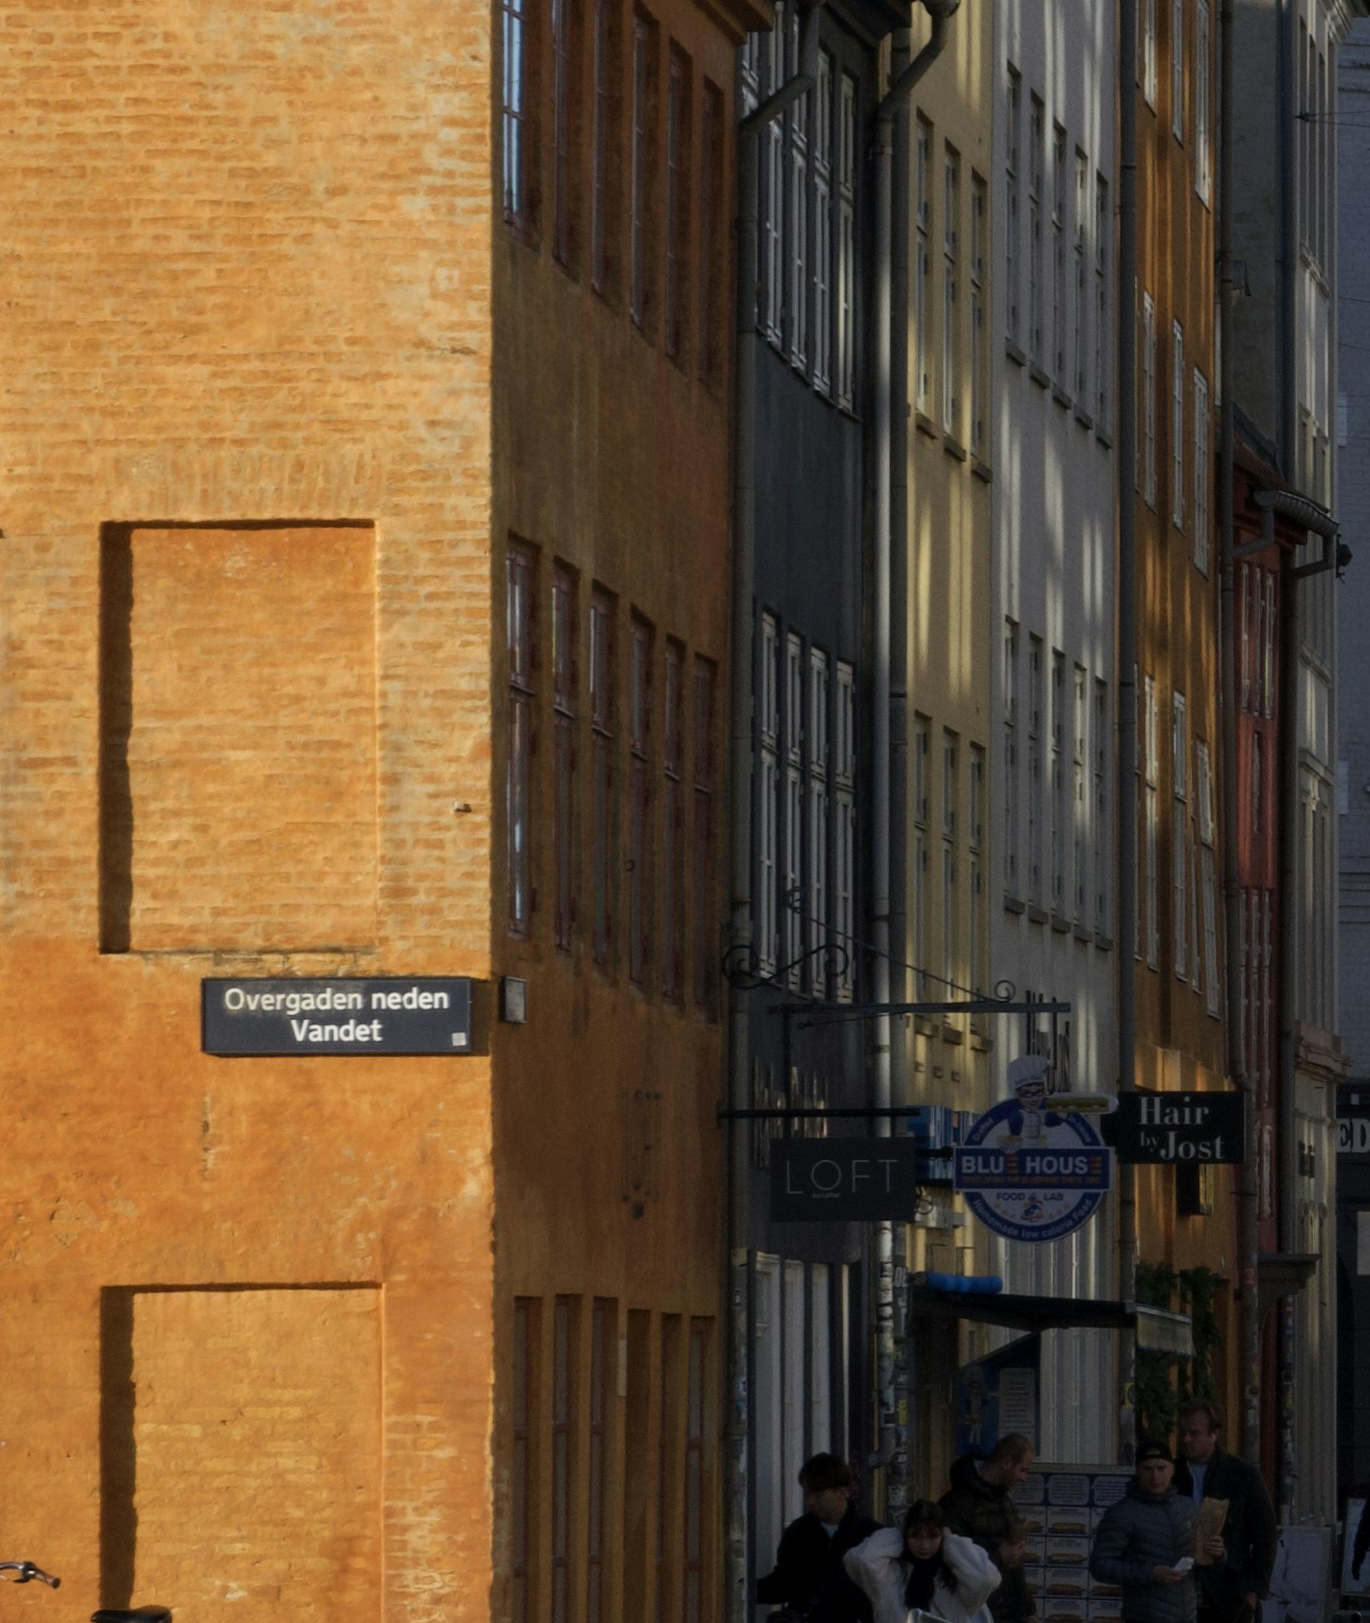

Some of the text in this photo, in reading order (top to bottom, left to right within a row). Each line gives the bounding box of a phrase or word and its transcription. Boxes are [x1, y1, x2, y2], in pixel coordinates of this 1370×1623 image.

[224, 986, 449, 1015] Overgaden neden
[291, 1019, 383, 1042] Vandet
[1138, 1095, 1210, 1125] Hair
[1140, 1130, 1225, 1160] by Jost
[786, 1159, 898, 1195] LOFT
[961, 1154, 1102, 1175] BLUE HOUSE
[996, 1192, 1064, 1201] FOOD LAB
[972, 1199, 1020, 1238] Homemade
[1020, 1227, 1041, 1239] low
[1072, 1198, 1094, 1223] Food
